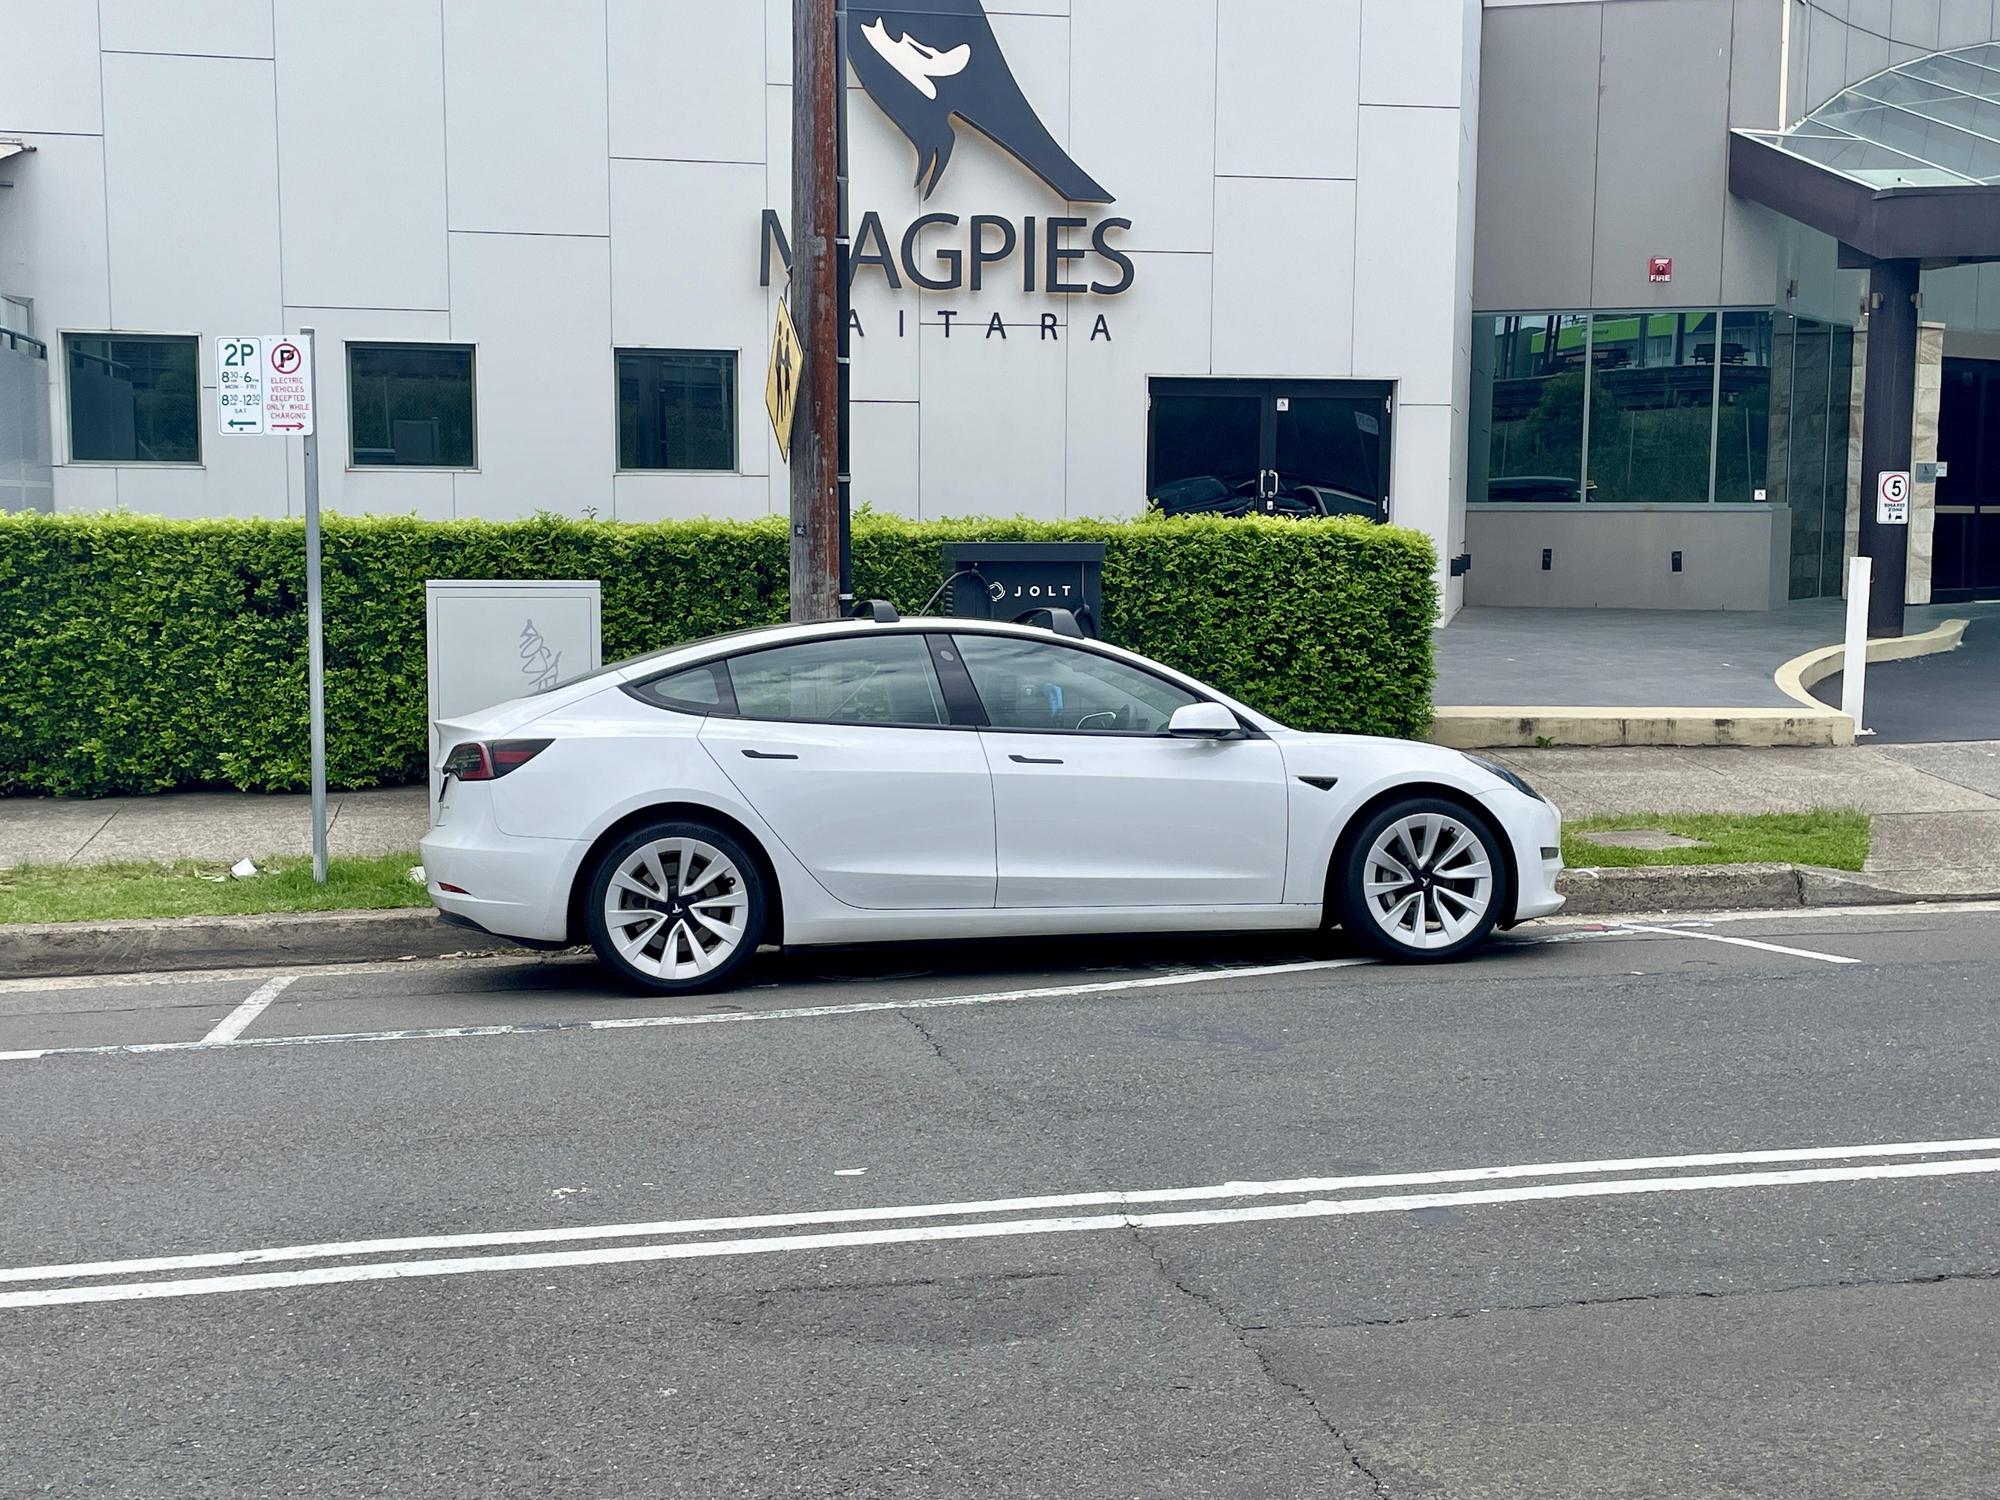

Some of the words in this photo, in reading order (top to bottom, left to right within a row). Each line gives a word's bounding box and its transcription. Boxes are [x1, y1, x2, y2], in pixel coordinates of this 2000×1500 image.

[1650, 274, 1671, 282] FIRE
[224, 343, 254, 367] 2P
[270, 377, 304, 385] ELECTRIC
[270, 394, 306, 402] EXCEPTED
[266, 403, 285, 411] ONLY
[289, 403, 311, 411] WHILE
[270, 412, 307, 420] CHARGING
[1891, 480, 1902, 497] 5
[1013, 585, 1072, 598] JOLT
